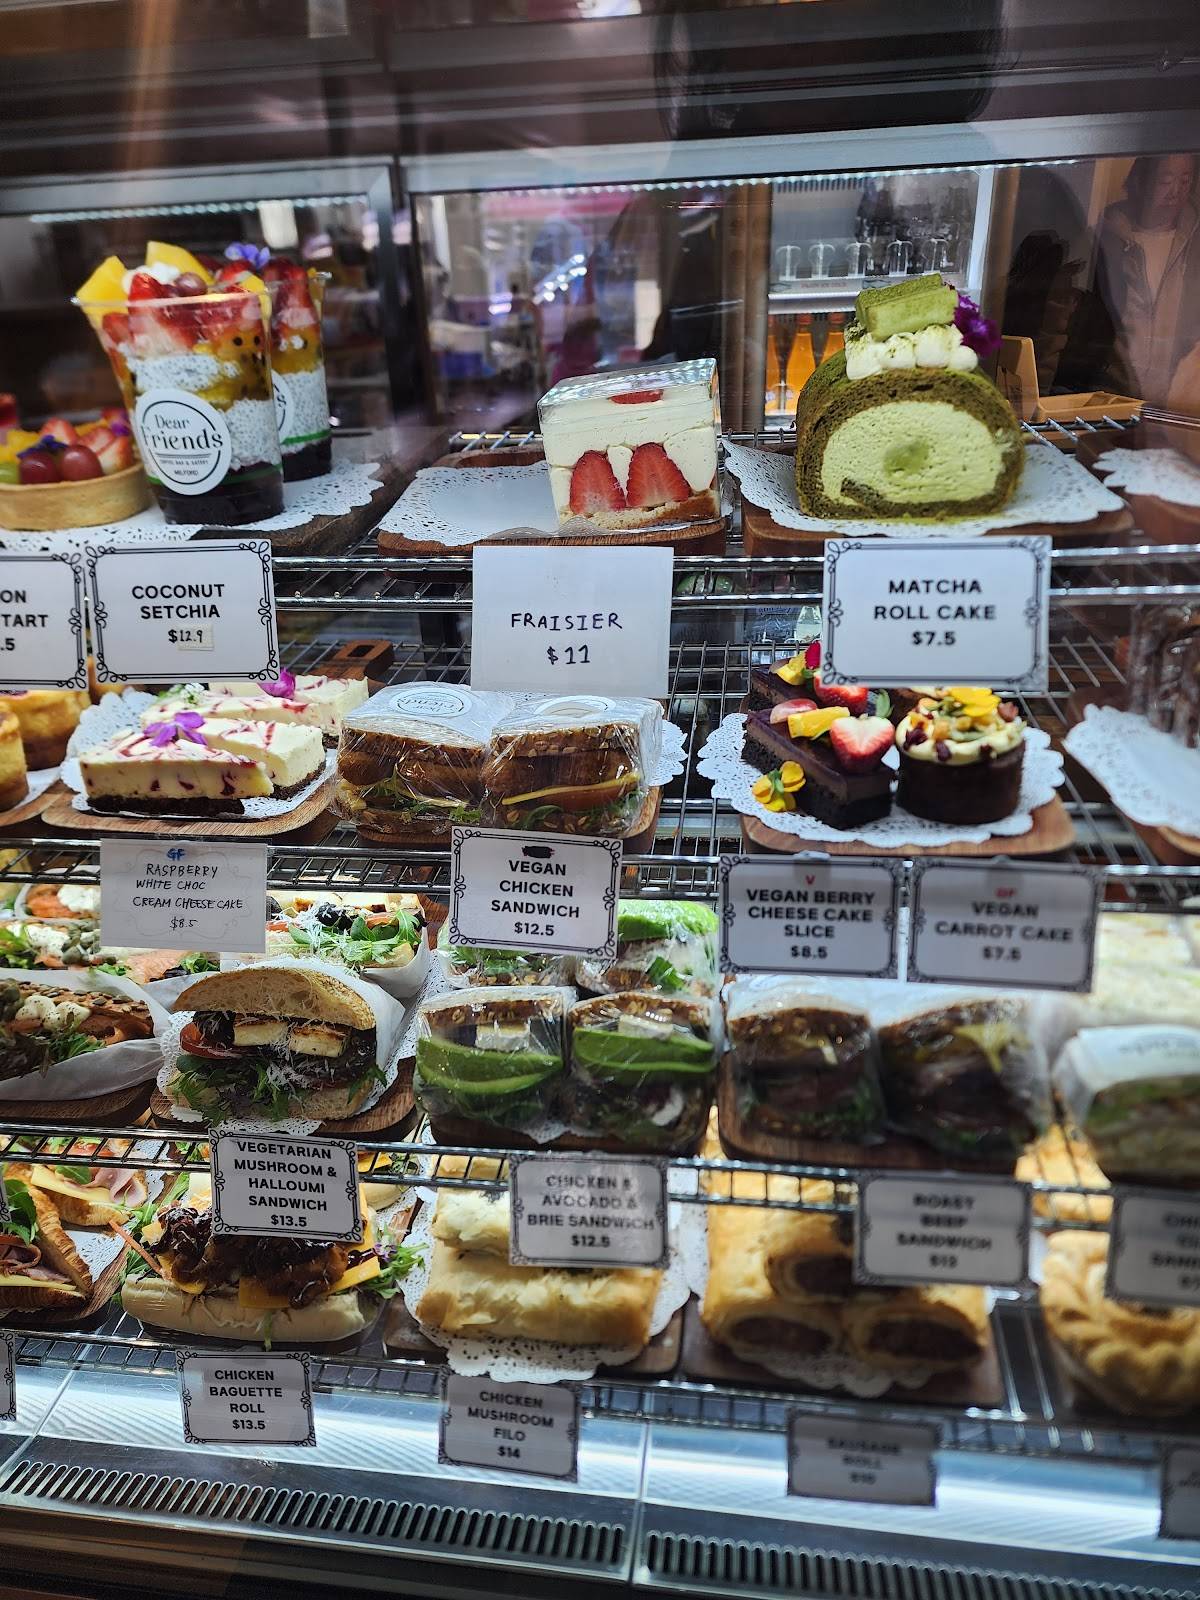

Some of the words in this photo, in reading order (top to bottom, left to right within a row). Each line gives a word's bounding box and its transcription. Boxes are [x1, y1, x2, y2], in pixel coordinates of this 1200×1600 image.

[154, 414, 190, 430] Dear
[141, 428, 223, 450] Friends
[131, 583, 225, 600] COCONUT
[888, 579, 982, 595] MATCHA
[140, 604, 221, 620] SETCHIA
[874, 605, 929, 620] ROLL
[938, 605, 997, 620] CAKE
[1, 613, 49, 628] TART
[511, 612, 623, 631] FRAISIER
[168, 629, 203, 645] $12.9
[912, 631, 956, 646] $7.5
[547, 644, 590, 665] $11
[146, 863, 218, 879] RASPBERRY
[508, 859, 566, 876] VEGAN
[136, 879, 172, 890] WHITE
[177, 880, 206, 890] CHOC
[805, 875, 816, 885] V
[499, 880, 573, 897] CHICKEN
[133, 896, 171, 909] CREAM
[747, 889, 808, 902] VEGAN
[813, 891, 875, 905] BERRY
[491, 900, 580, 918] SANDWICH
[748, 906, 818, 920] CHEESE
[824, 908, 873, 922] CAKE
[972, 902, 1039, 918] VEGAN
[170, 917, 198, 931] $8.5
[514, 922, 555, 937] $12.5
[784, 924, 835, 938] SLICE
[935, 921, 1015, 938] CARROT
[1021, 926, 1074, 942] CAKE
[237, 1141, 332, 1159] VEGETARIAN
[234, 1159, 323, 1176] MUSHROOM
[327, 1167, 337, 1177] &
[249, 1178, 325, 1194] HALLOUMI
[546, 1176, 617, 1189] CHICKEN
[249, 1195, 327, 1211] SANDWICH
[542, 1194, 622, 1209] AVOCADO
[270, 1214, 307, 1227] $13.5
[528, 1215, 564, 1226] BRIE
[569, 1215, 655, 1230] SANDWICH
[571, 1235, 610, 1248] $12.5
[214, 1370, 274, 1381] CHICKEN
[209, 1386, 282, 1398] BAGUETTE
[479, 1391, 544, 1408] CHICKEN
[230, 1403, 265, 1413] ROLL
[232, 1419, 266, 1430] $13.5
[468, 1407, 554, 1427] MUSHROOM
[494, 1427, 526, 1442] FILO
[497, 1446, 521, 1459] $14
